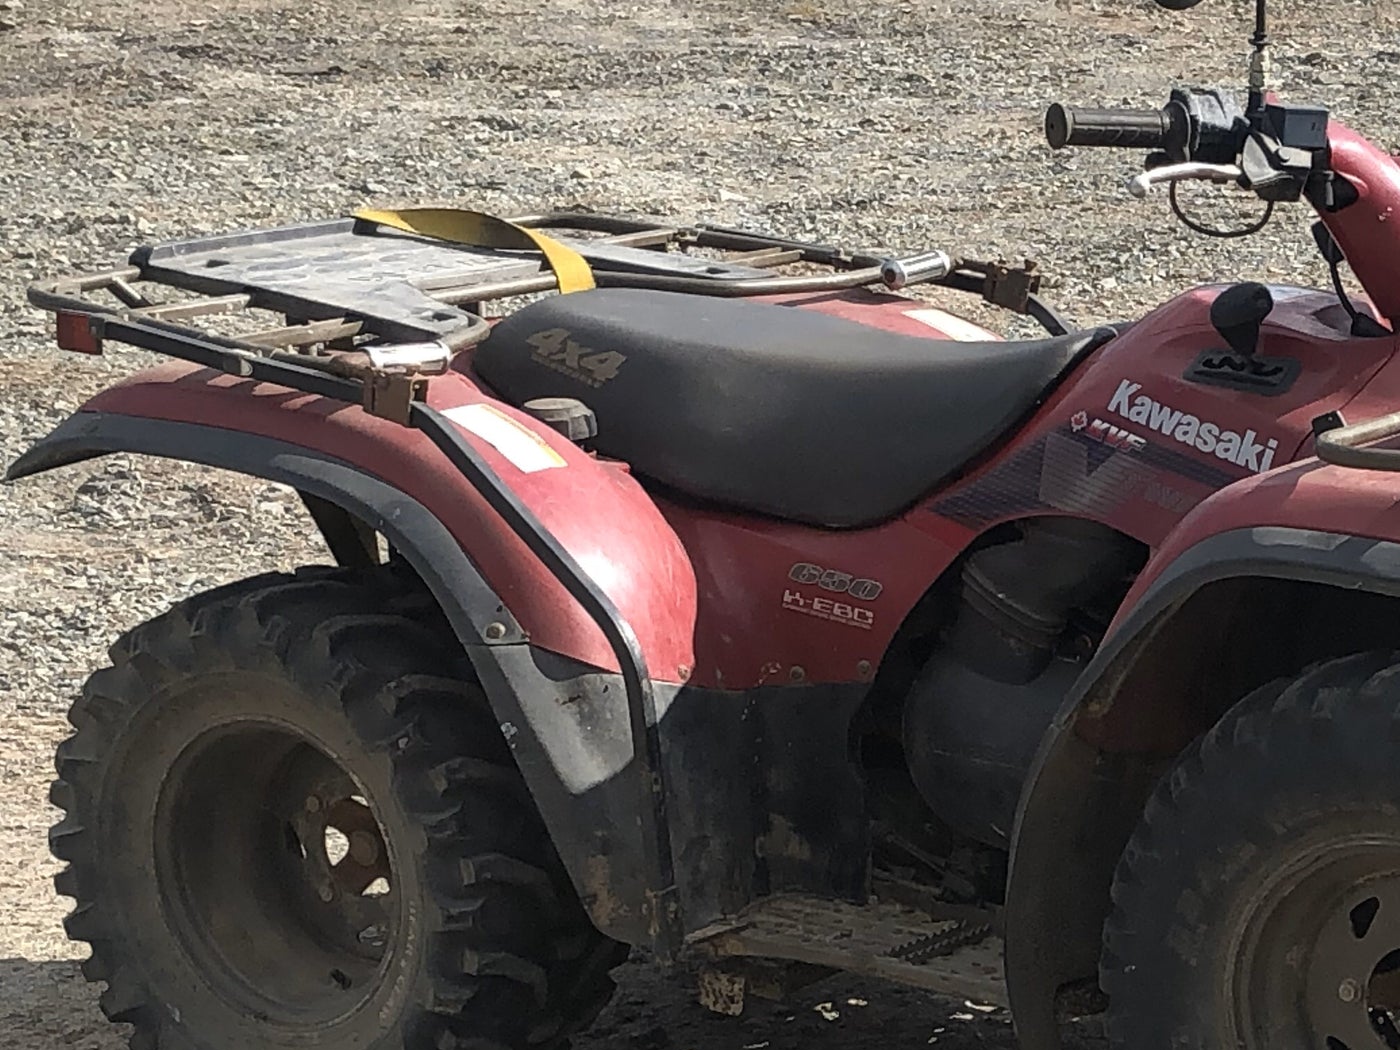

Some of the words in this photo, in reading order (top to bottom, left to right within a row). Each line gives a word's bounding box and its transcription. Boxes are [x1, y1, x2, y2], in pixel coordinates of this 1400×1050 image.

[1087, 418, 1148, 452] KVF
[1107, 378, 1279, 473] Kawasaki
[788, 562, 884, 601] 650
